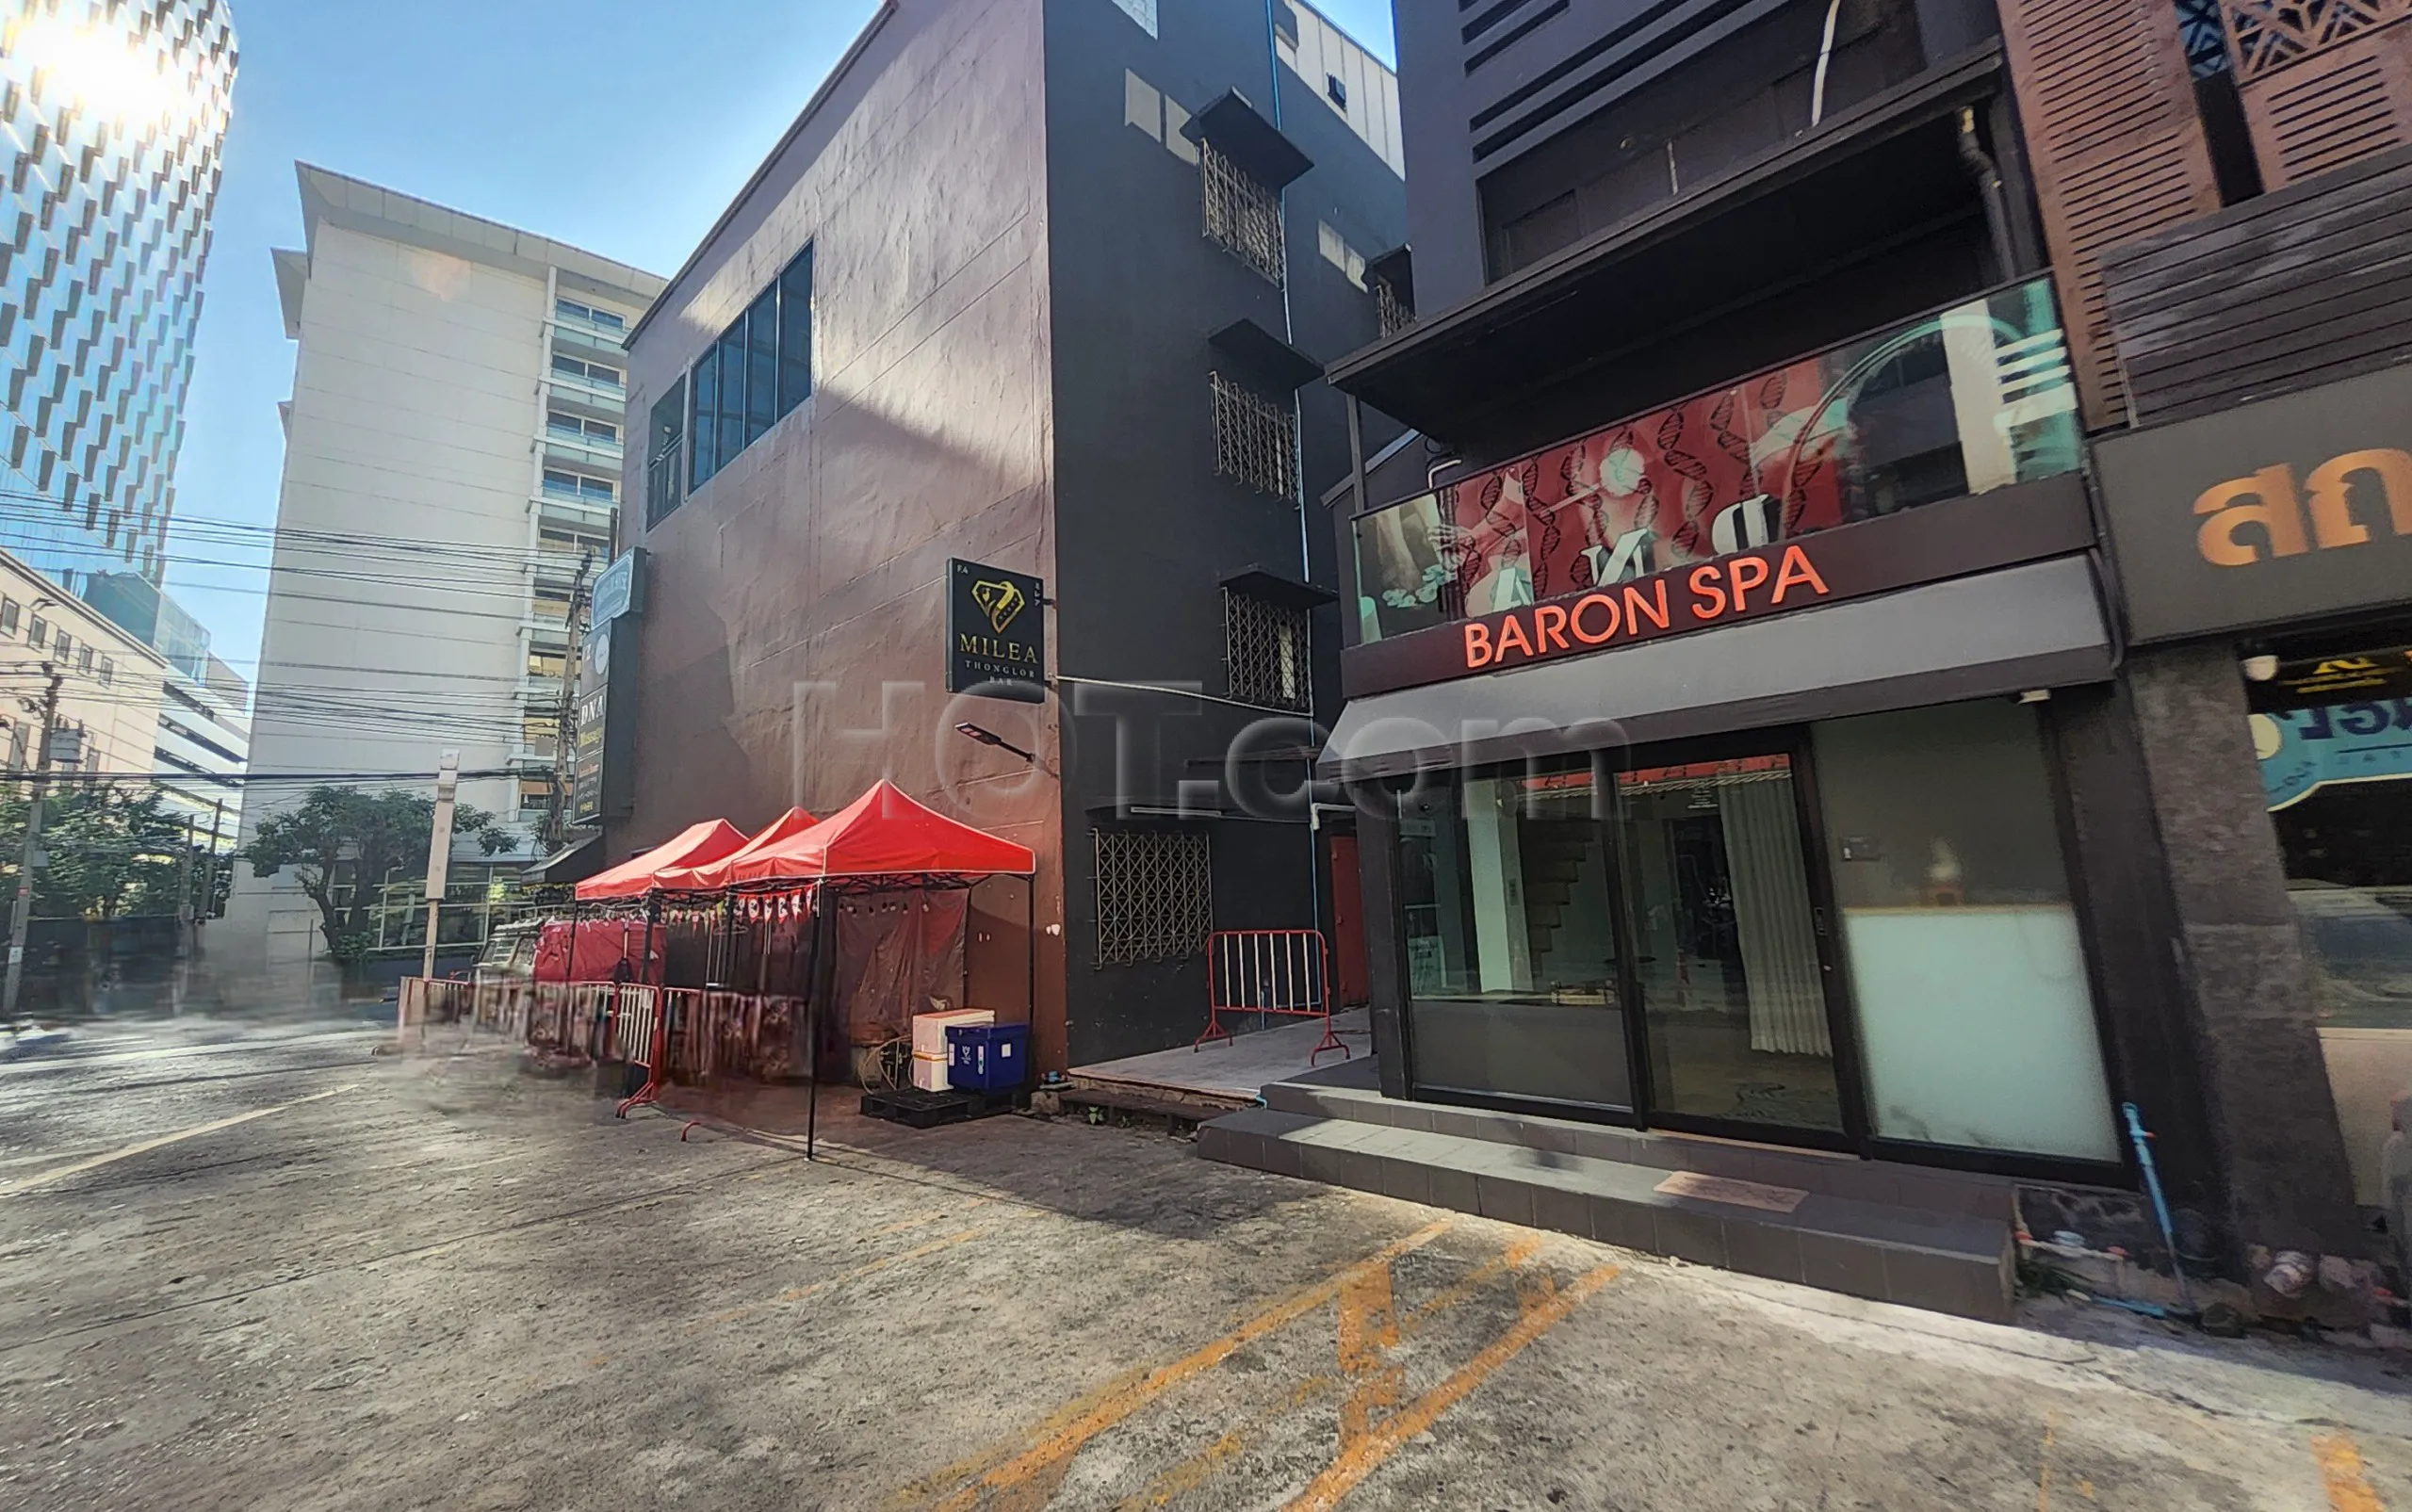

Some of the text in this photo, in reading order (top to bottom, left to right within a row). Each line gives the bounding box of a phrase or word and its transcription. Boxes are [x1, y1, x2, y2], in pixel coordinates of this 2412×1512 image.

[1464, 545, 1829, 668] BARON SPA
[959, 632, 1038, 664] MILEA
[965, 660, 1035, 678] THONGLOR
[989, 675, 1013, 687] BAR
[580, 695, 604, 727] DNA
